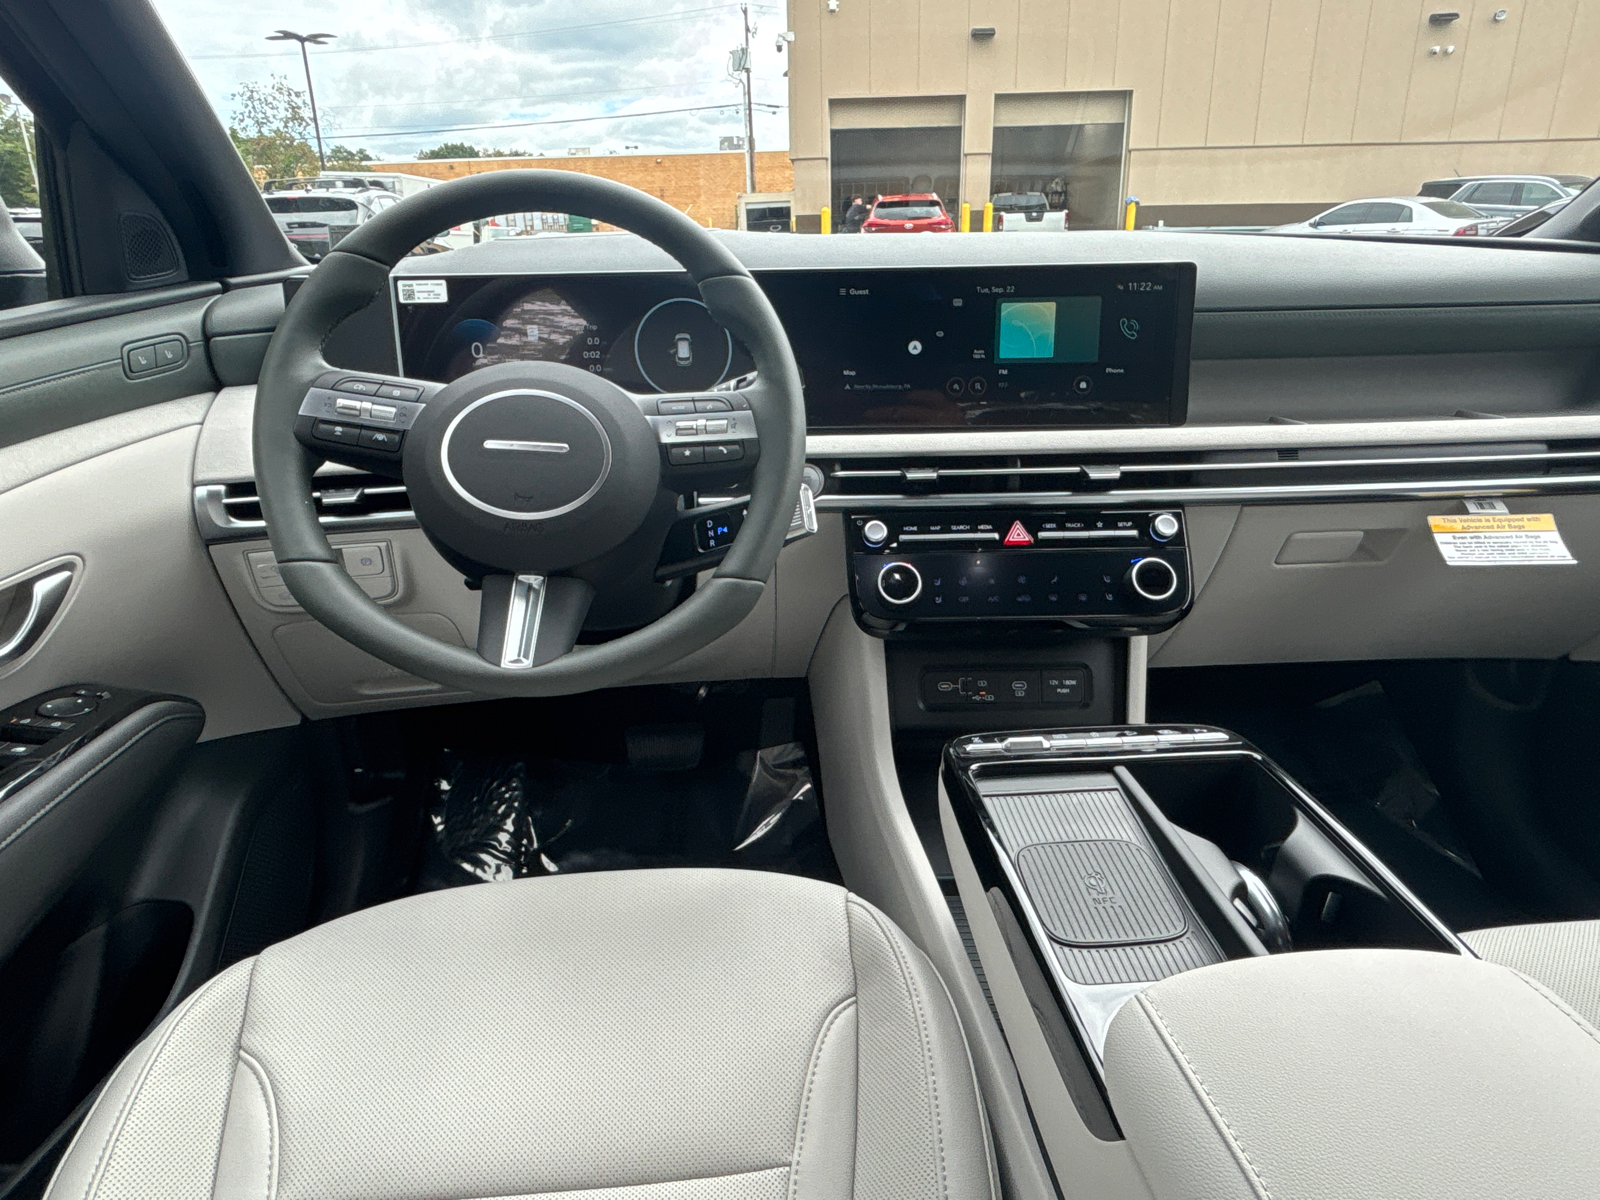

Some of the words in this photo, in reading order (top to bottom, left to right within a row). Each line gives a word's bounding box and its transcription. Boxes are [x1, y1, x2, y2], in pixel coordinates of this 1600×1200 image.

[1128, 282, 1152, 290] 11:22
[587, 337, 600, 345] 0.0
[471, 342, 483, 358] 0
[583, 351, 601, 359] 0:02
[589, 364, 602, 372] 0.0
[706, 520, 713, 528] D
[1458, 516, 1483, 524] Vehicle
[1492, 516, 1525, 524] Equipped
[708, 529, 715, 538] N
[709, 539, 716, 547] R
[1092, 897, 1117, 905] NFC
